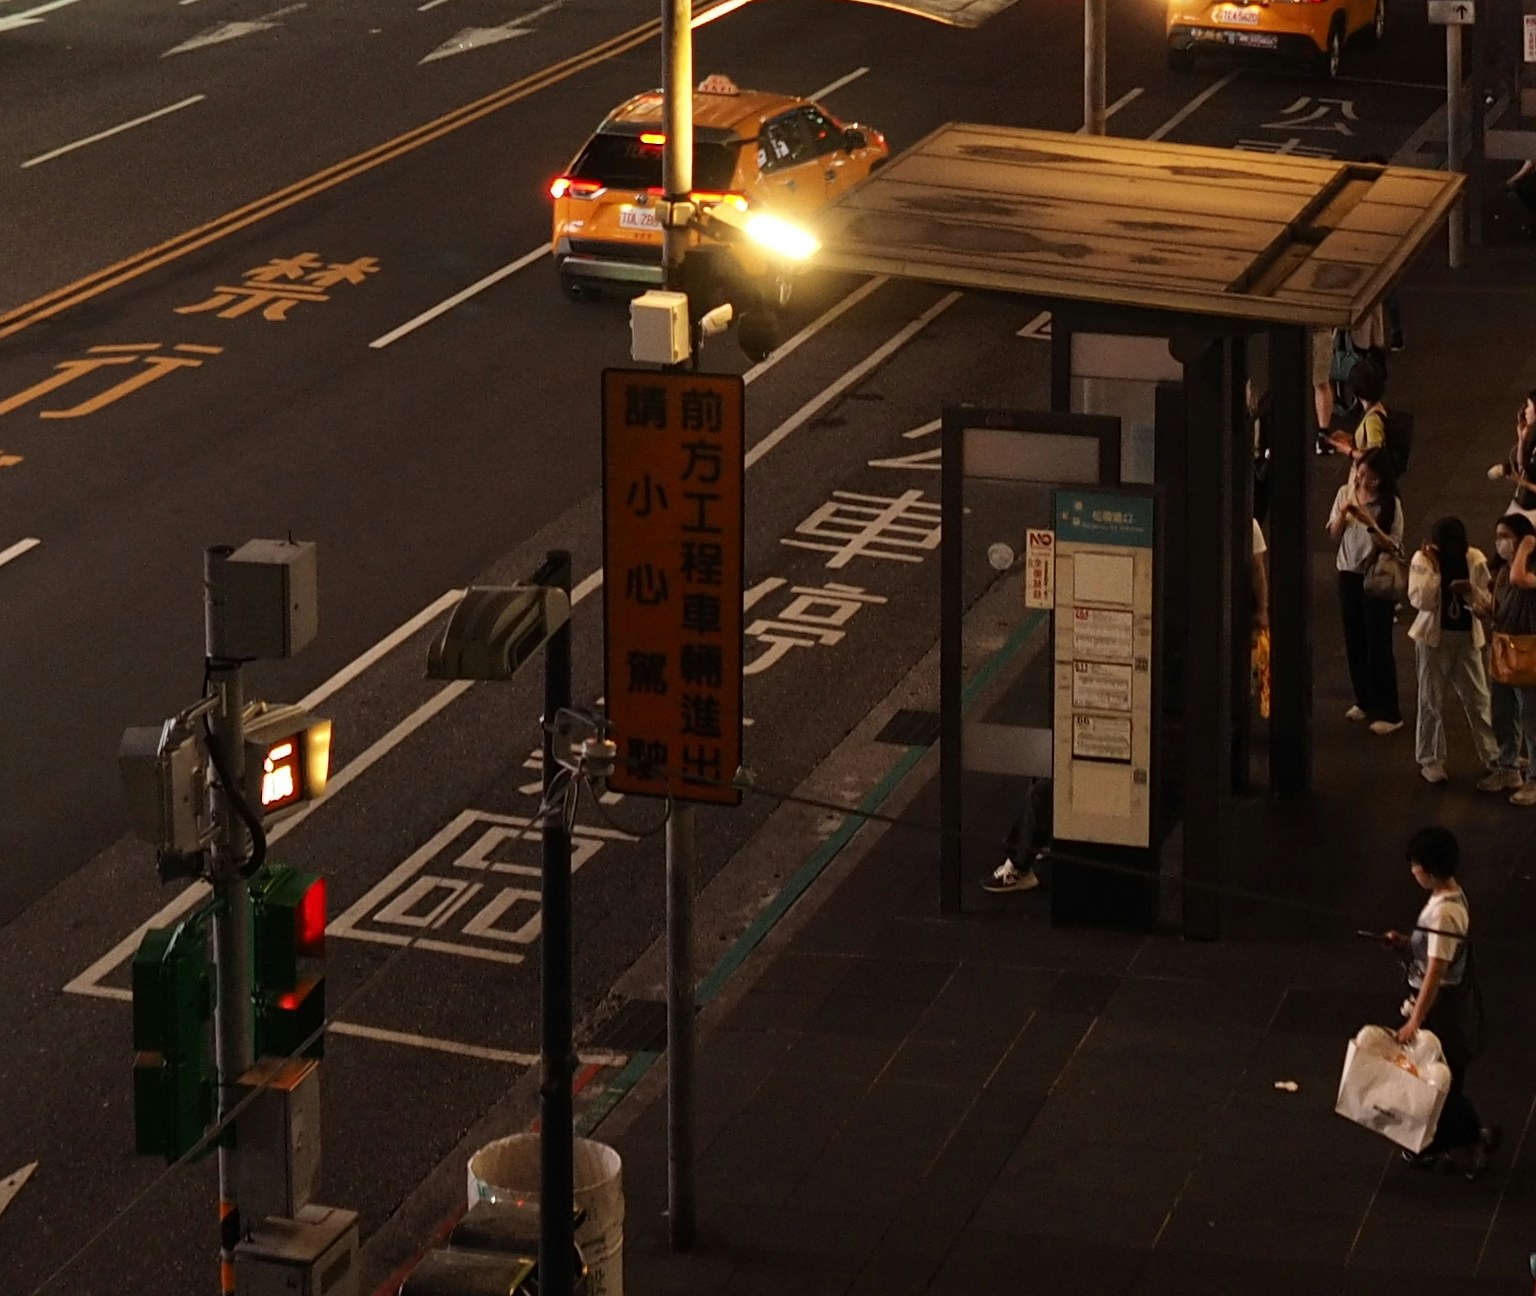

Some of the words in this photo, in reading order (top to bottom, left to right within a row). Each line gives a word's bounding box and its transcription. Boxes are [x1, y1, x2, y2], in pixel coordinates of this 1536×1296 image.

[624, 384, 670, 783] 請小心駕駛
[679, 385, 724, 785] 前方工程車輛進出
